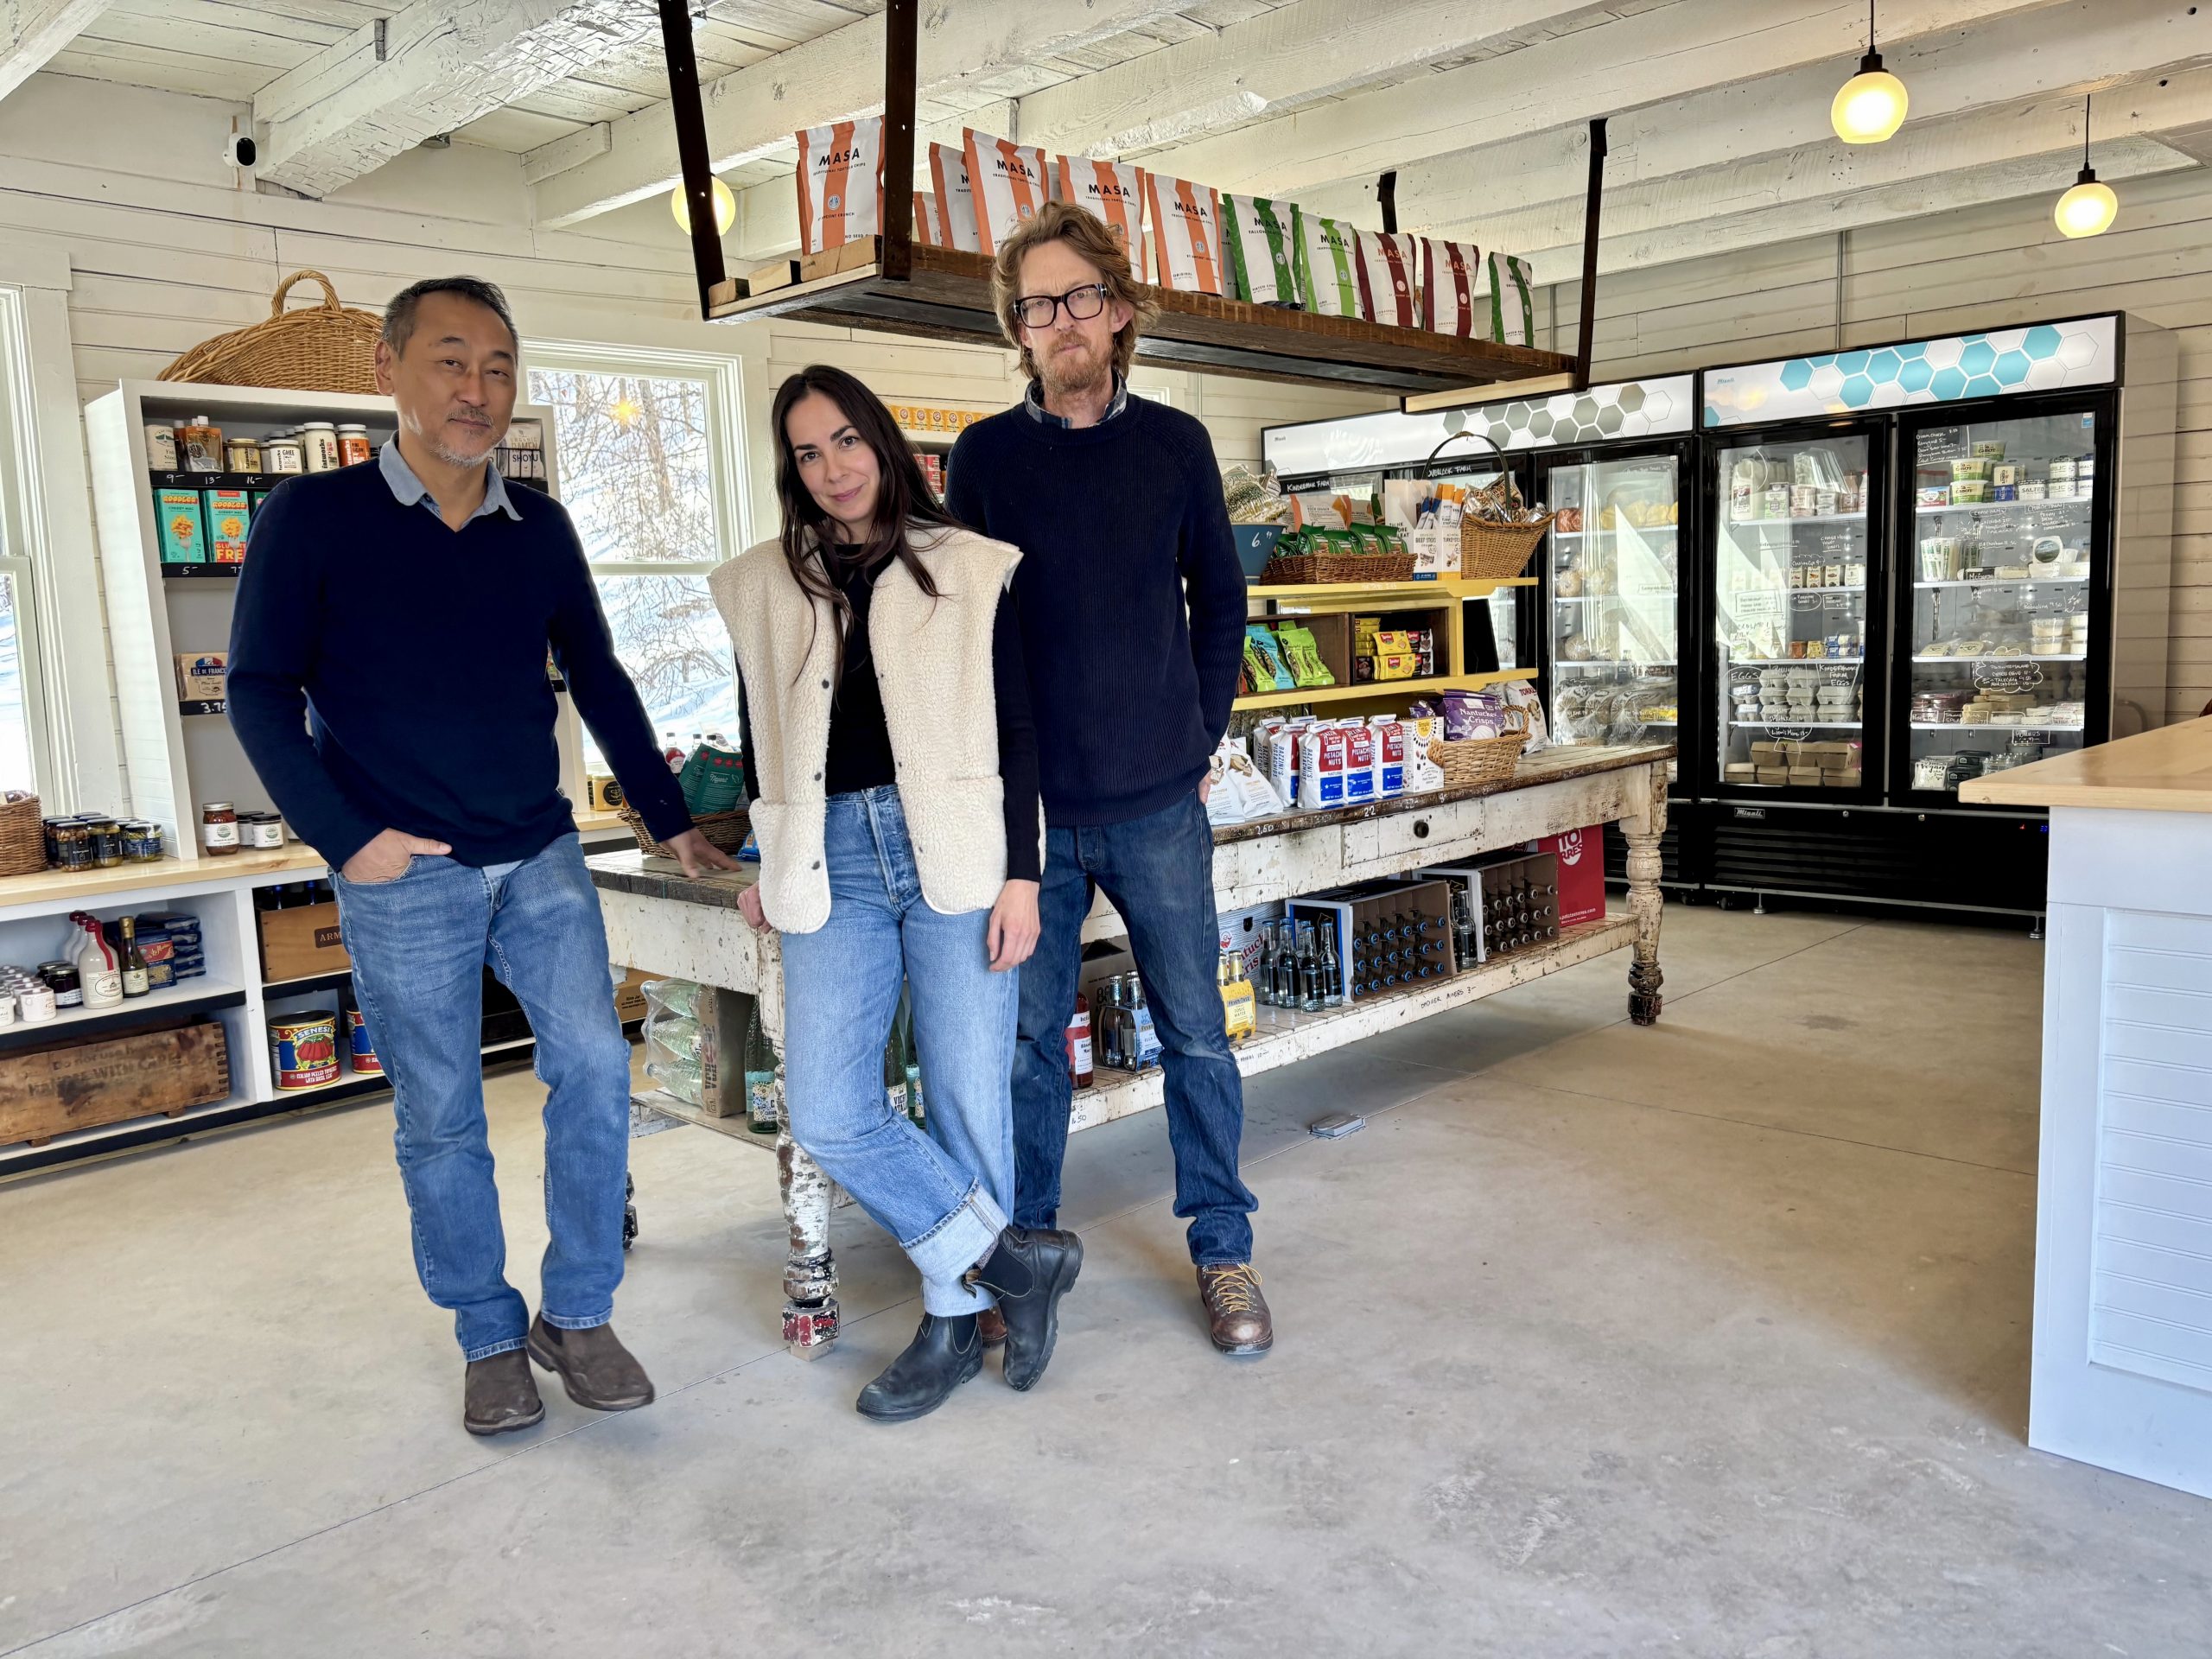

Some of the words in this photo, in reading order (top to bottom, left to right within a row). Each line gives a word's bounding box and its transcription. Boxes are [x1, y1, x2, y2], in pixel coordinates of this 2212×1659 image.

[819, 148, 860, 166] MASA
[997, 159, 1035, 179] MASA
[1088, 184, 1131, 197] MASA
[1175, 201, 1208, 216] MASA
[1254, 217, 1287, 232] MASA
[1320, 234, 1349, 248] MASA
[1377, 248, 1408, 259] MASA
[1445, 260, 1472, 271] MASA
[320, 439, 328, 469] fatworks
[1456, 465, 1472, 474] FARM
[1731, 672, 1759, 681] EGGS
[1364, 806, 1376, 817] 22
[320, 932, 341, 942] ARM
[297, 1026, 331, 1039] SENESI
